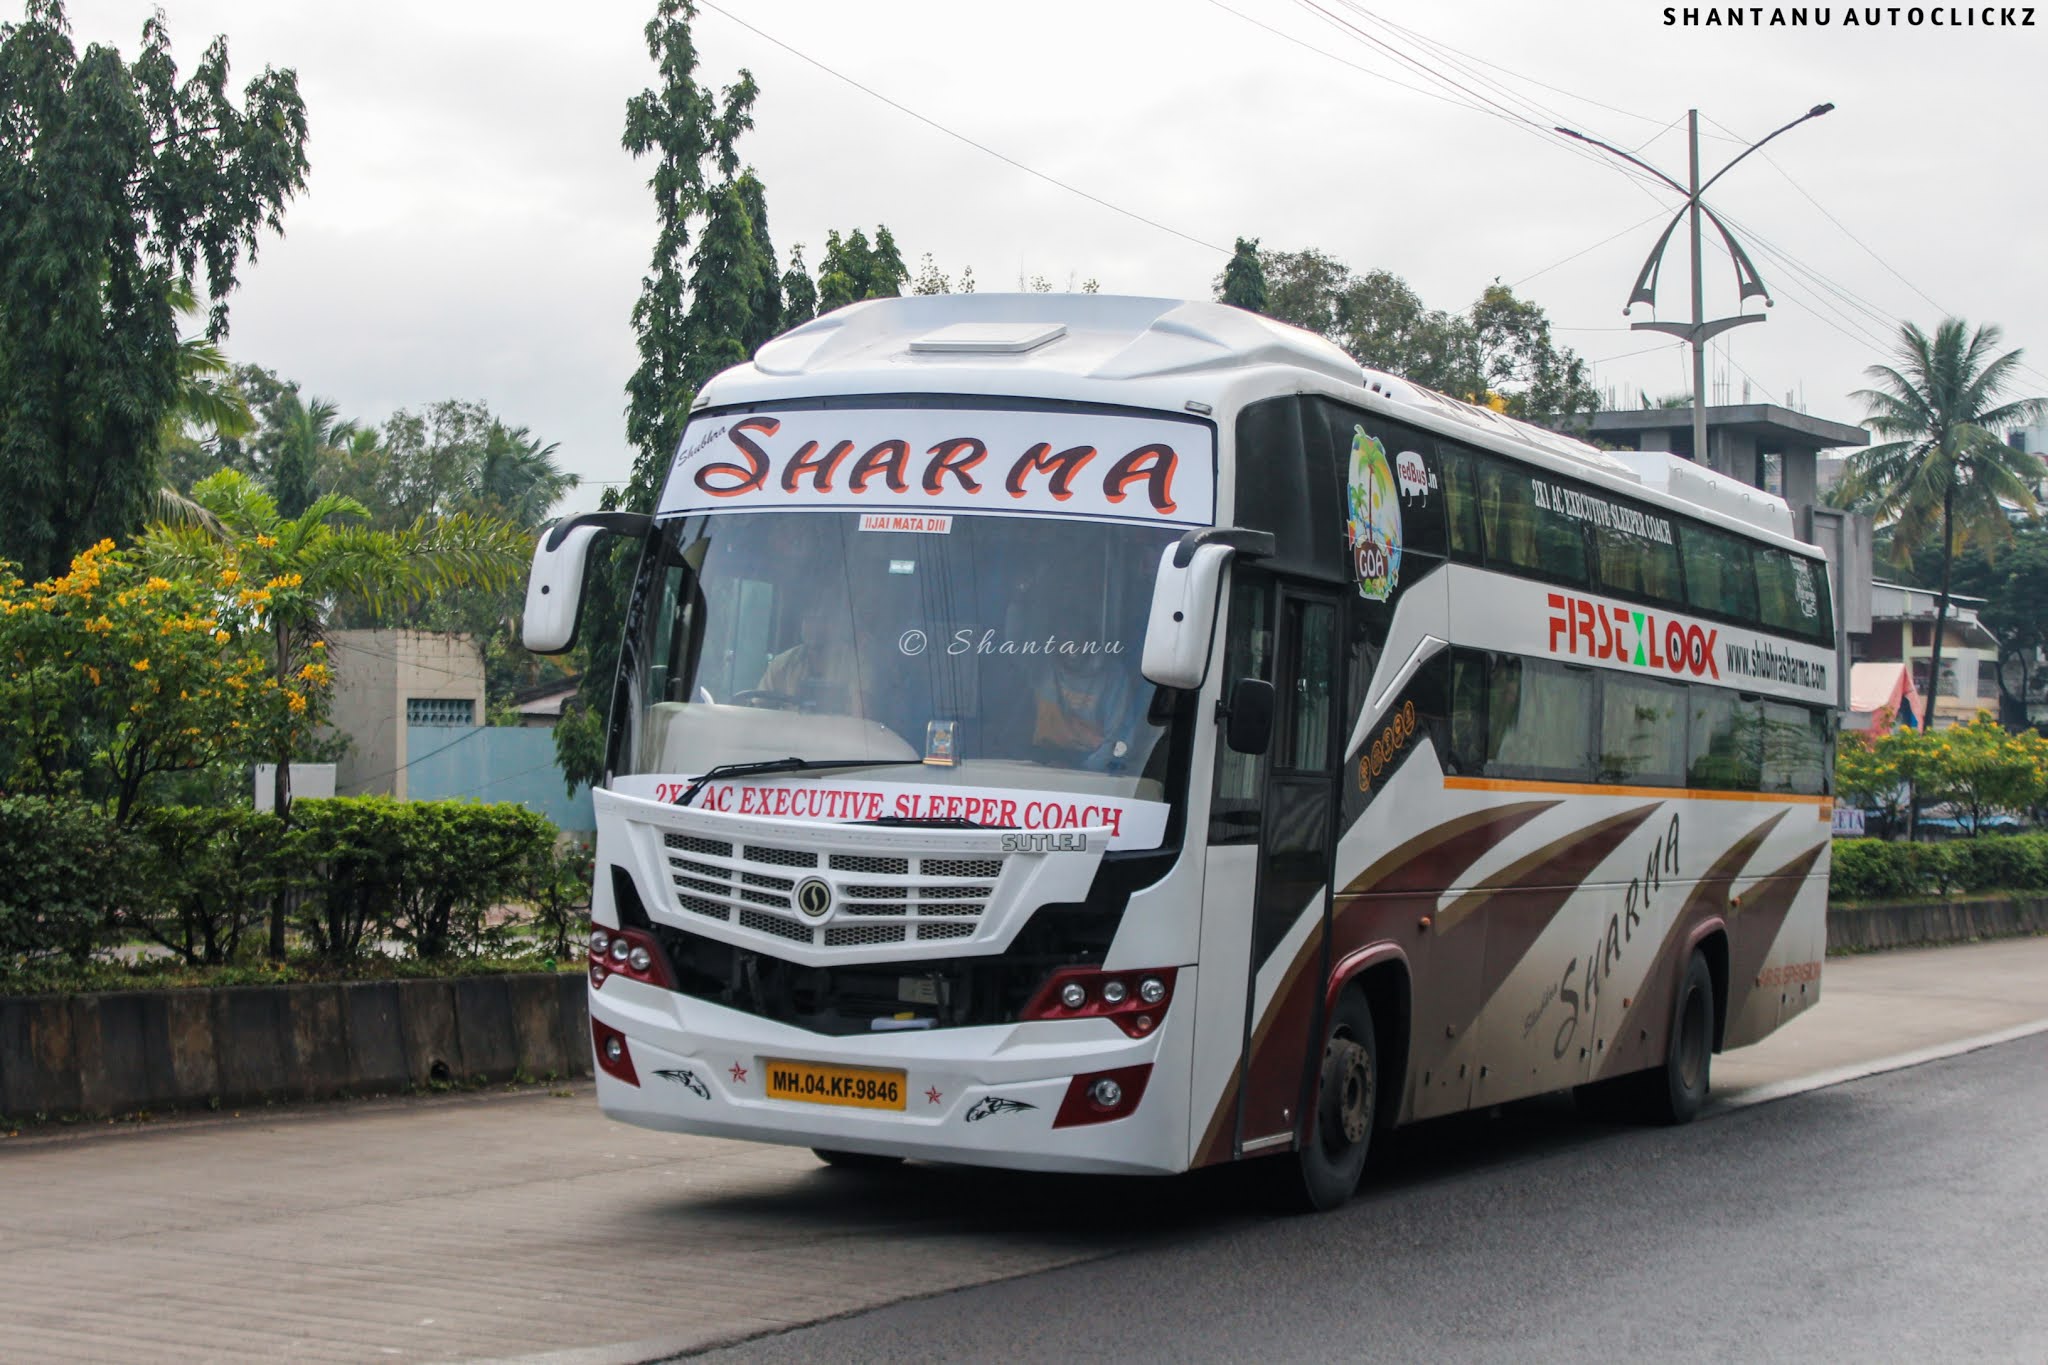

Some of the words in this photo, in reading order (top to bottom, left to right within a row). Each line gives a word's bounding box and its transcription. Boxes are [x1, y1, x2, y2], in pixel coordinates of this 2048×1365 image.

[678, 426, 727, 467] Shubhra
[694, 416, 1178, 515] SHARMA
[893, 517, 923, 531] MATA
[1532, 478, 1551, 510] 2X1
[1551, 484, 1565, 514] AC
[1645, 515, 1673, 545] COACH
[1359, 549, 1385, 578] GOA
[1547, 592, 1630, 663] FIRST
[1647, 615, 1720, 681] LOOK
[1725, 640, 1827, 692] www.shubhrasharma.com
[656, 783, 693, 804] 2X
[701, 786, 734, 811] AC
[738, 786, 884, 820] EXECUTIVE
[894, 794, 1017, 828] SLEEPER
[1024, 801, 1123, 837] COACH
[1001, 833, 1087, 852] SUTLEJ
[1554, 812, 1680, 1060] SHARMA
[773, 1071, 898, 1102] MH.04.KF.9846
